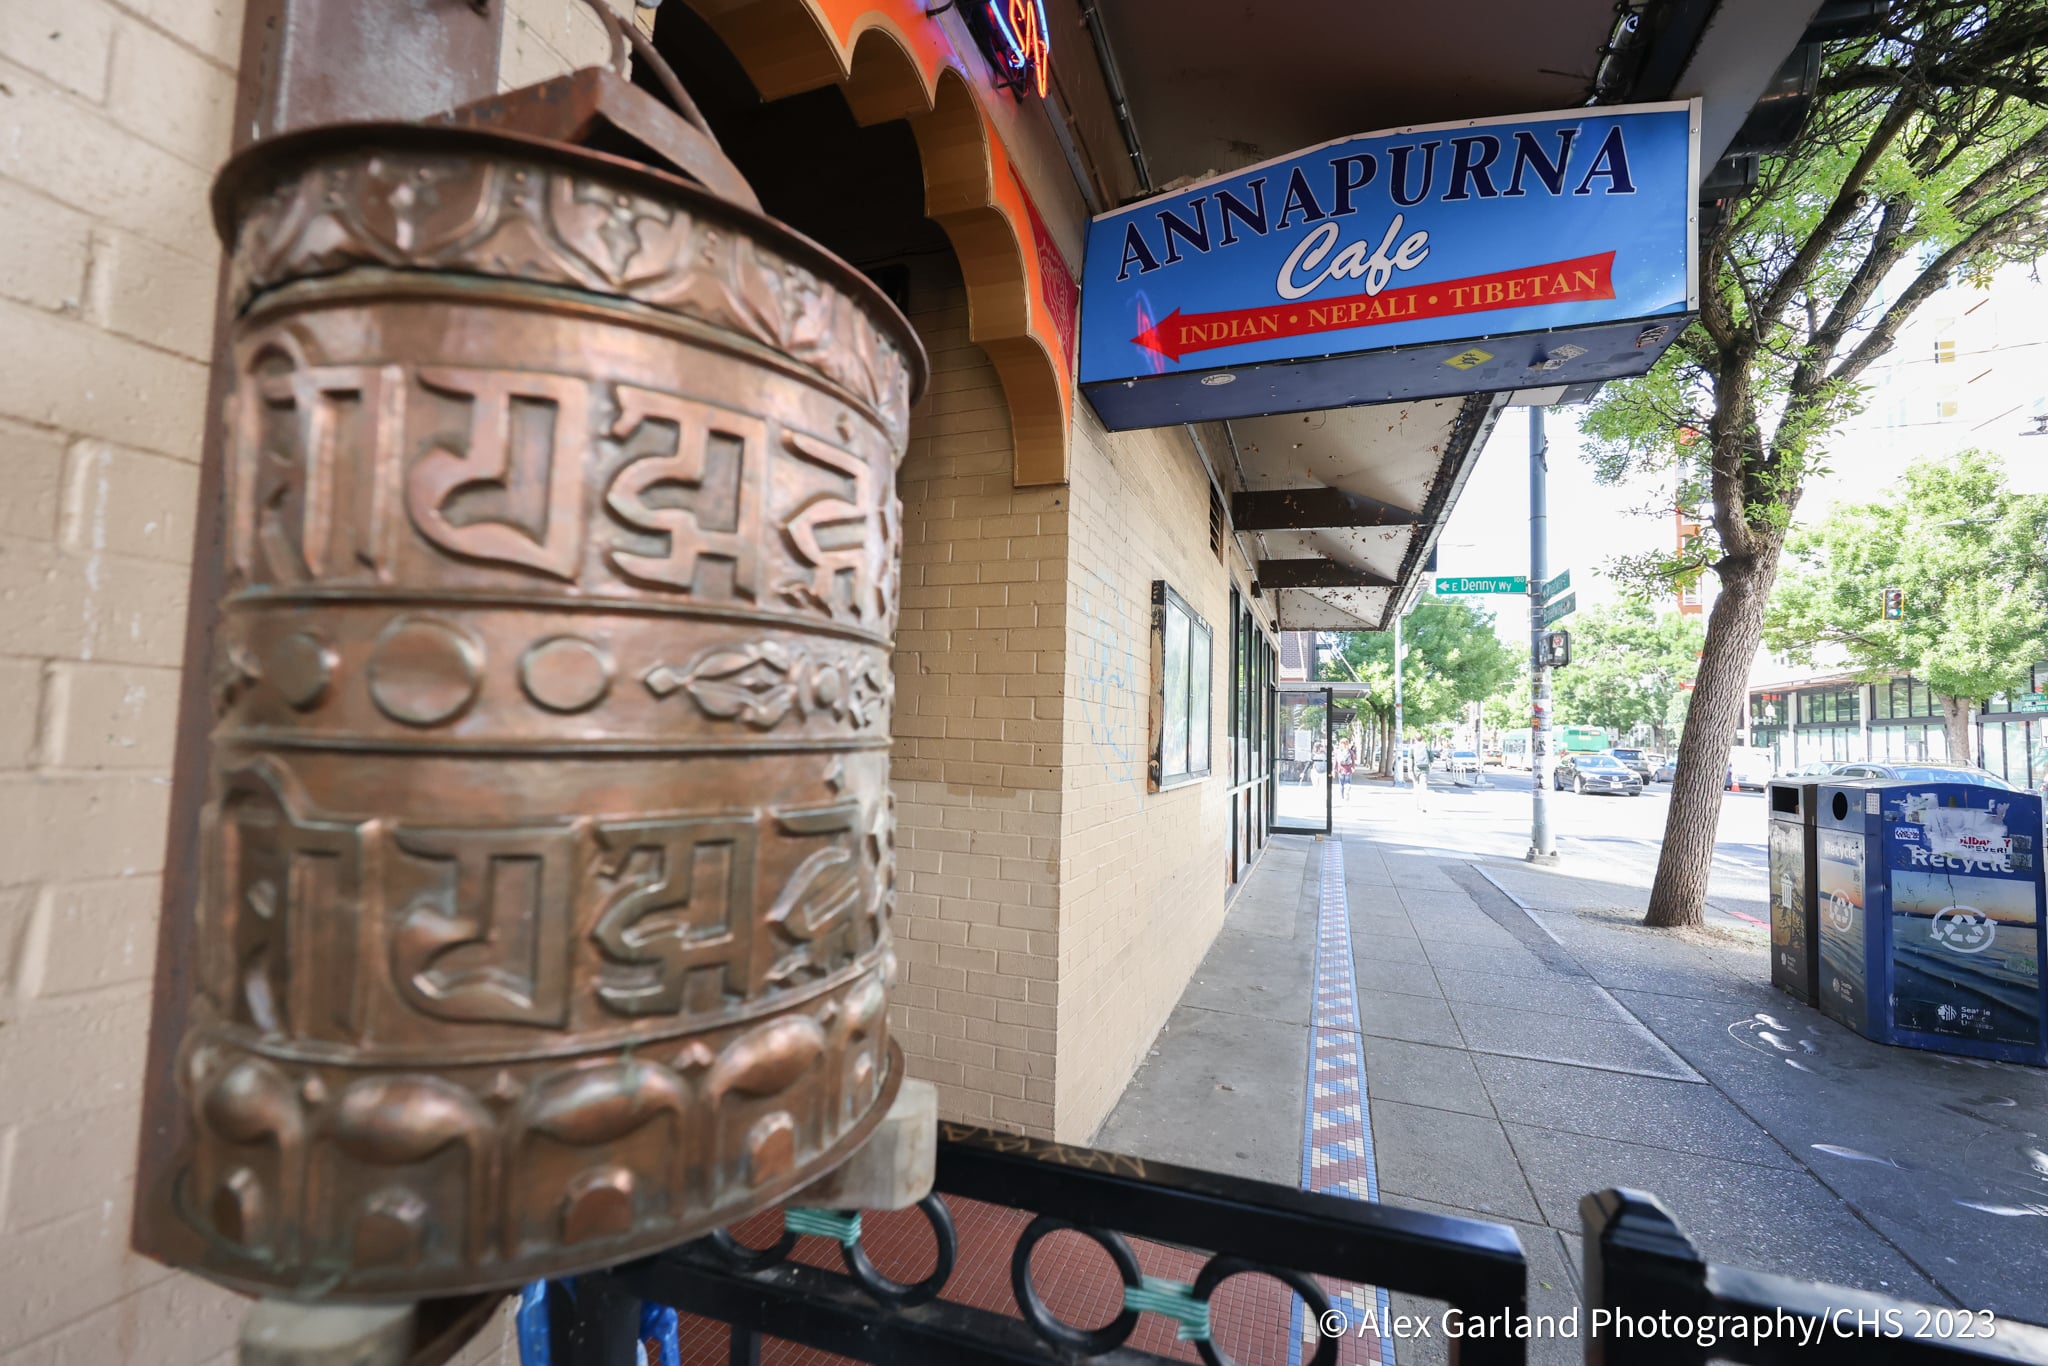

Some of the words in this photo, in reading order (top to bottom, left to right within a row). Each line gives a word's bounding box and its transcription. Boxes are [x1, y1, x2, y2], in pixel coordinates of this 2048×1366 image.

[1116, 125, 1637, 281] ANNAPURNA
[1276, 213, 1430, 300] Cafe
[1179, 314, 1280, 345] INDIAN
[1308, 294, 1418, 327] NEPALI
[1448, 268, 1598, 308] TIBETAN
[1452, 582, 1458, 591] E
[1461, 578, 1496, 592] Denny
[1499, 582, 1512, 592] Wy
[1824, 840, 1857, 859] Recycle
[1911, 846, 2014, 873] Recycle
